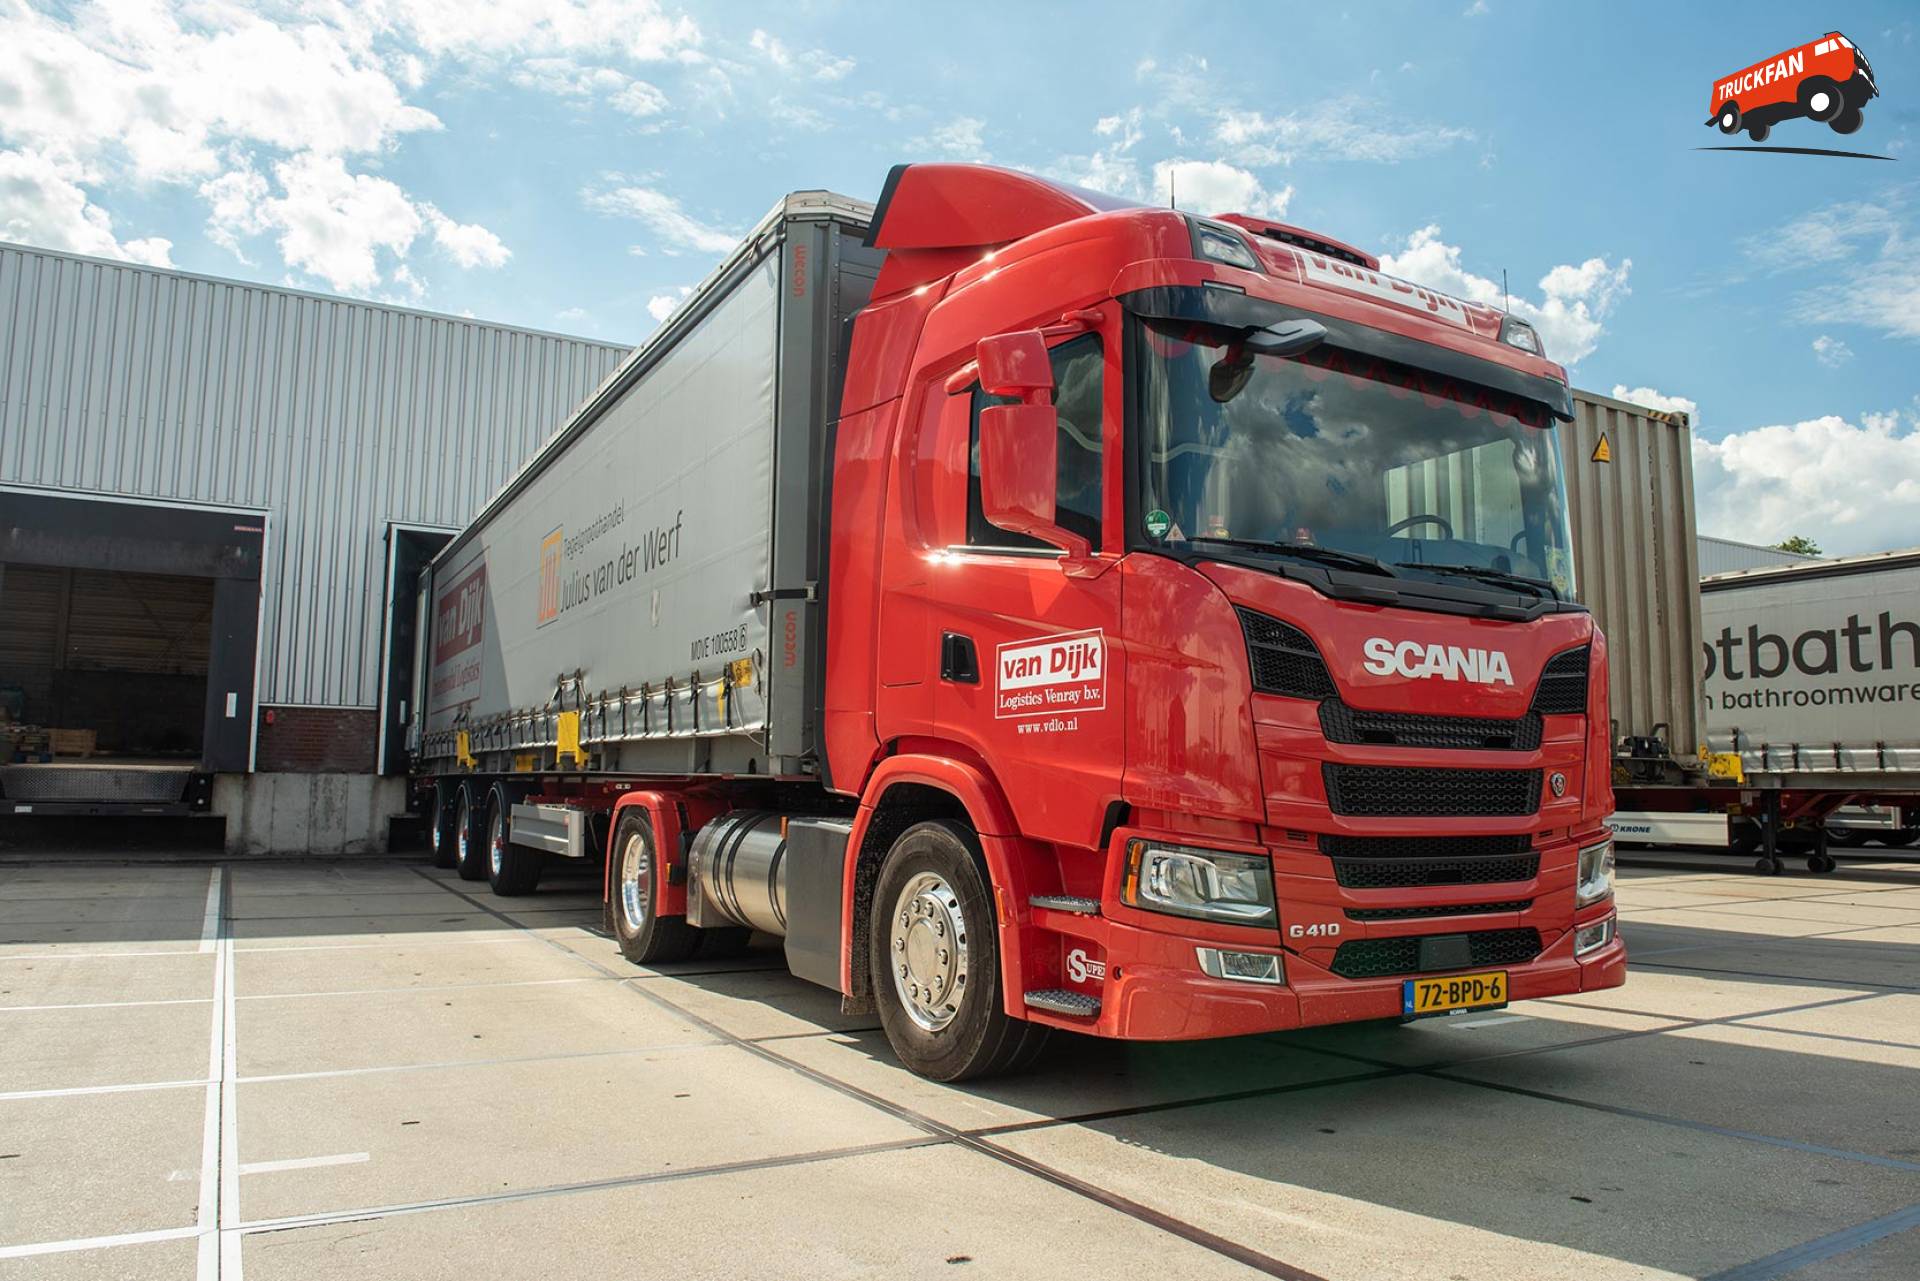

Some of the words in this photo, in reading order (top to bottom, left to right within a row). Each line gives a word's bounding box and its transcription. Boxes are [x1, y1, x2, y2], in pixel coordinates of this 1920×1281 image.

[560, 569, 590, 613] Julius
[593, 560, 614, 597] van
[617, 542, 640, 585] der
[643, 509, 683, 573] Werf
[458, 577, 484, 645] Dijk
[784, 609, 797, 668] wecon
[1004, 655, 1042, 679] van
[1050, 643, 1098, 679] Dijk
[1363, 638, 1514, 686] SCANIA
[1000, 690, 1043, 710] Logistics
[1044, 688, 1081, 704] Venray
[1084, 685, 1101, 701] b.v.
[1722, 682, 1920, 710] bathroomware
[1017, 717, 1078, 734] www.vdlo.nl
[1620, 825, 1651, 833] KRONE
[1405, 1000, 1413, 1009] NL
[1420, 977, 1501, 1007] 72-BPD-6
